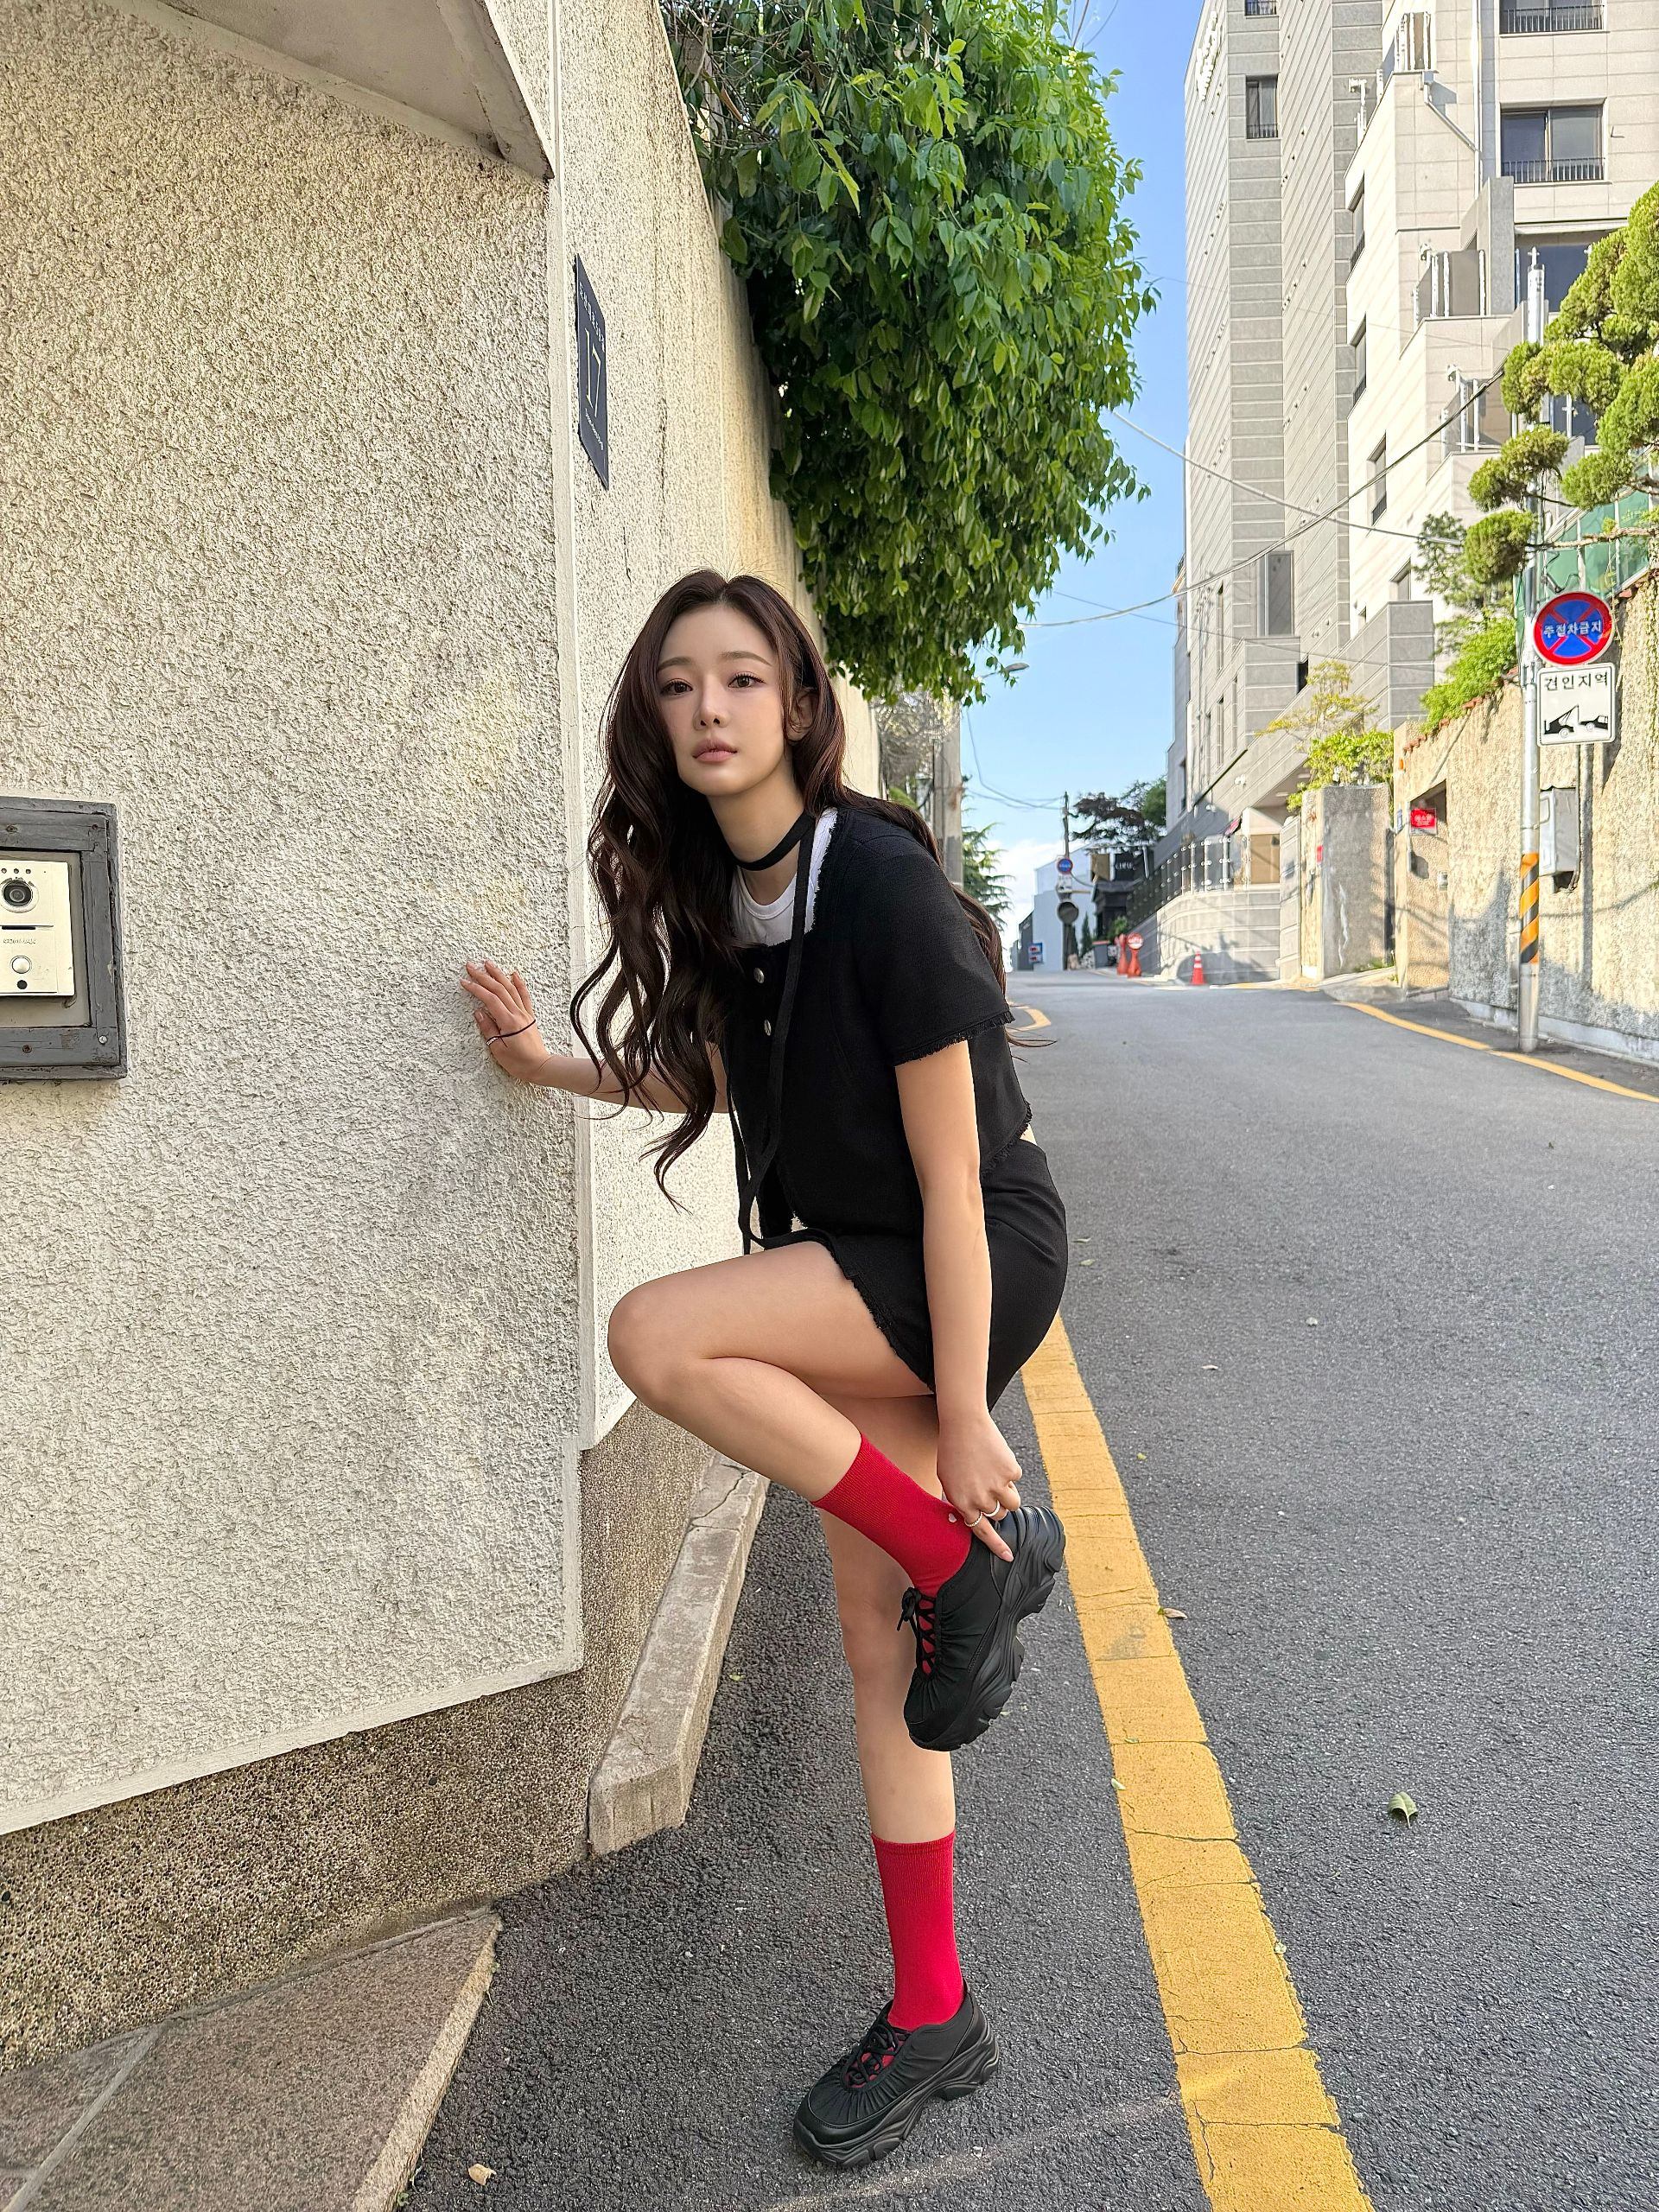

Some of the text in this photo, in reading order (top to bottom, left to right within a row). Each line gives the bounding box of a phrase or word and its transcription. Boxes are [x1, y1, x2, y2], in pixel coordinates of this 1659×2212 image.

[585, 328, 601, 418] 17
[1543, 620, 1602, 639] 주정차금지
[1544, 671, 1608, 691] 견인지역
